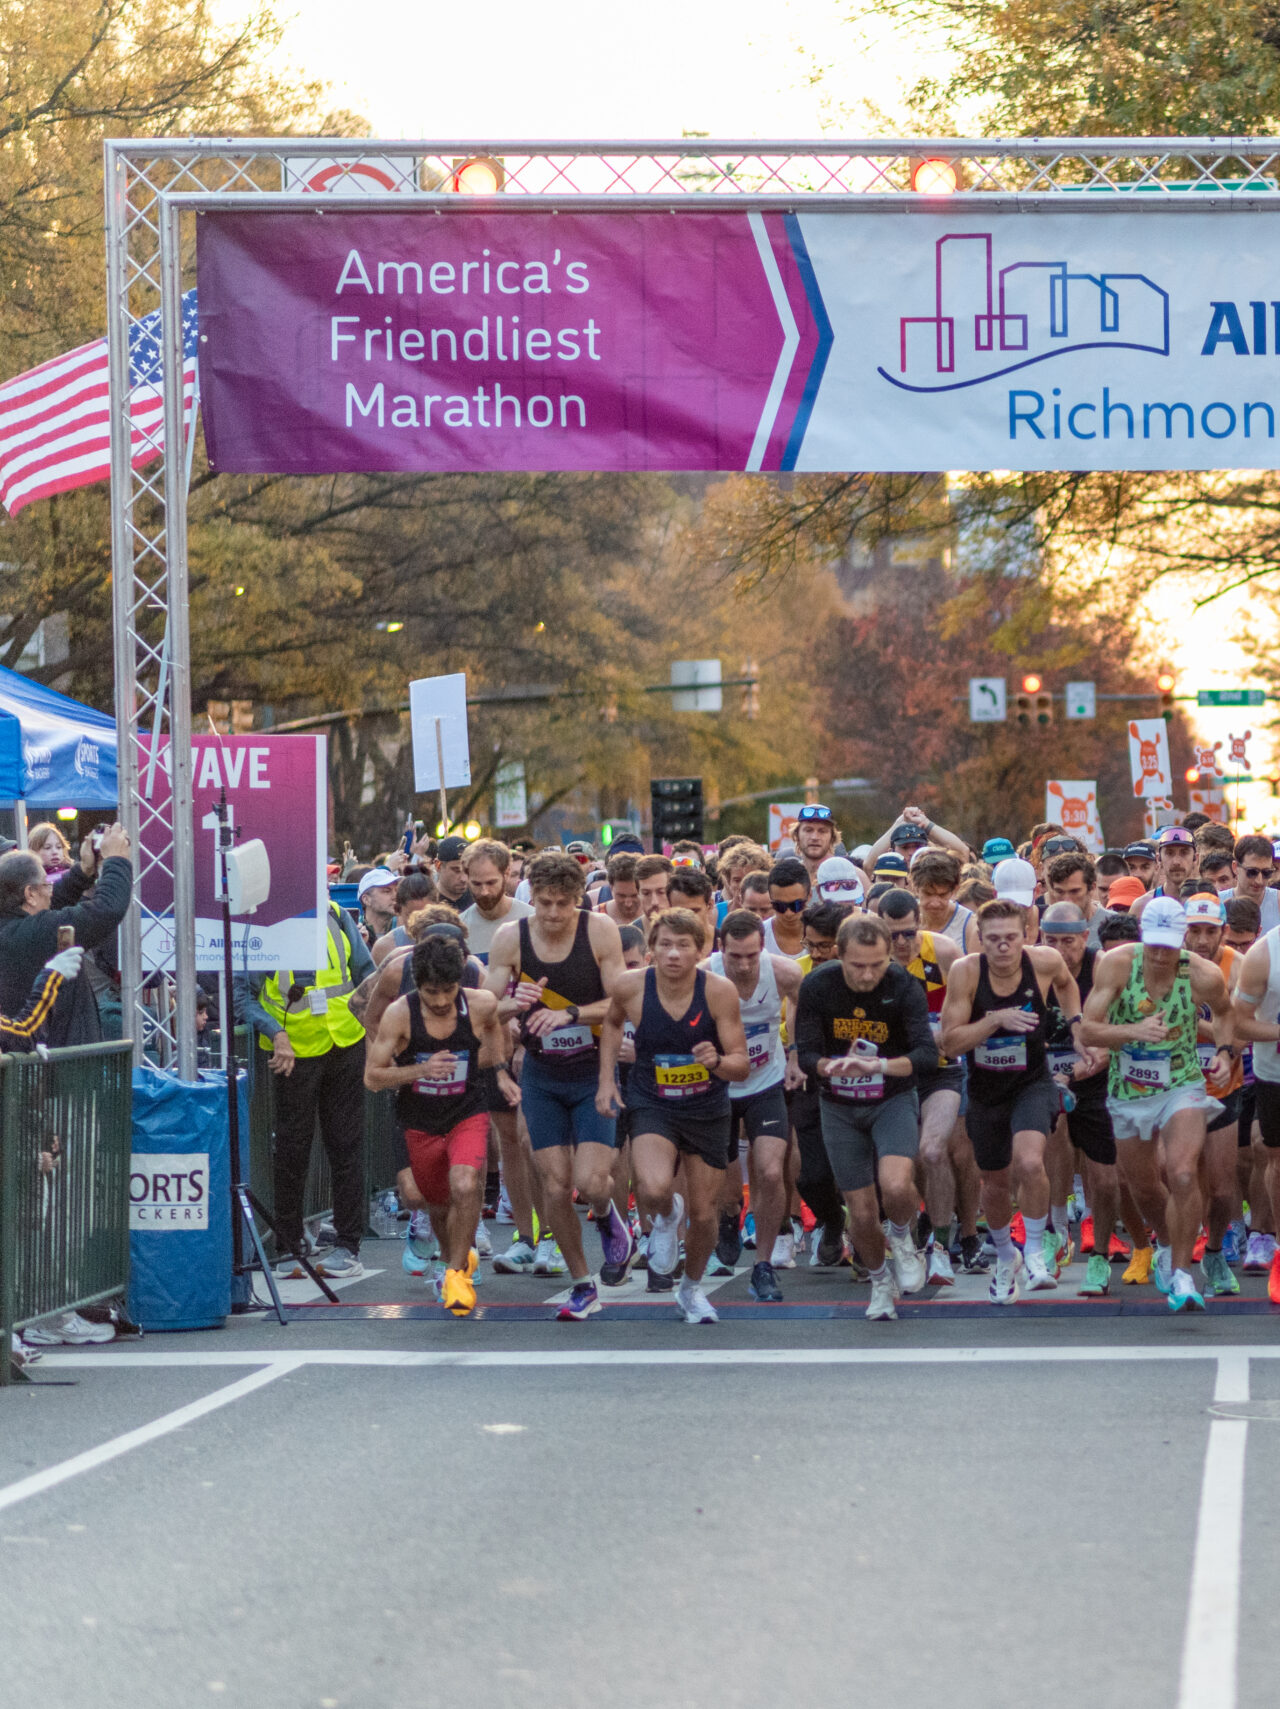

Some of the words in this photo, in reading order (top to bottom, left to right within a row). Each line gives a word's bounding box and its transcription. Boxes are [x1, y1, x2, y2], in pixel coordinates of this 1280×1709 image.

[335, 248, 590, 295] America's
[330, 316, 601, 362] Friendliest
[345, 383, 587, 427] Marathon
[1063, 810, 1086, 823] 3:30
[209, 938, 247, 948] Allanz
[551, 1036, 583, 1048] 3904
[984, 1055, 1016, 1065] 3866
[663, 1071, 703, 1084] 12233
[1128, 1065, 1160, 1081] 2893
